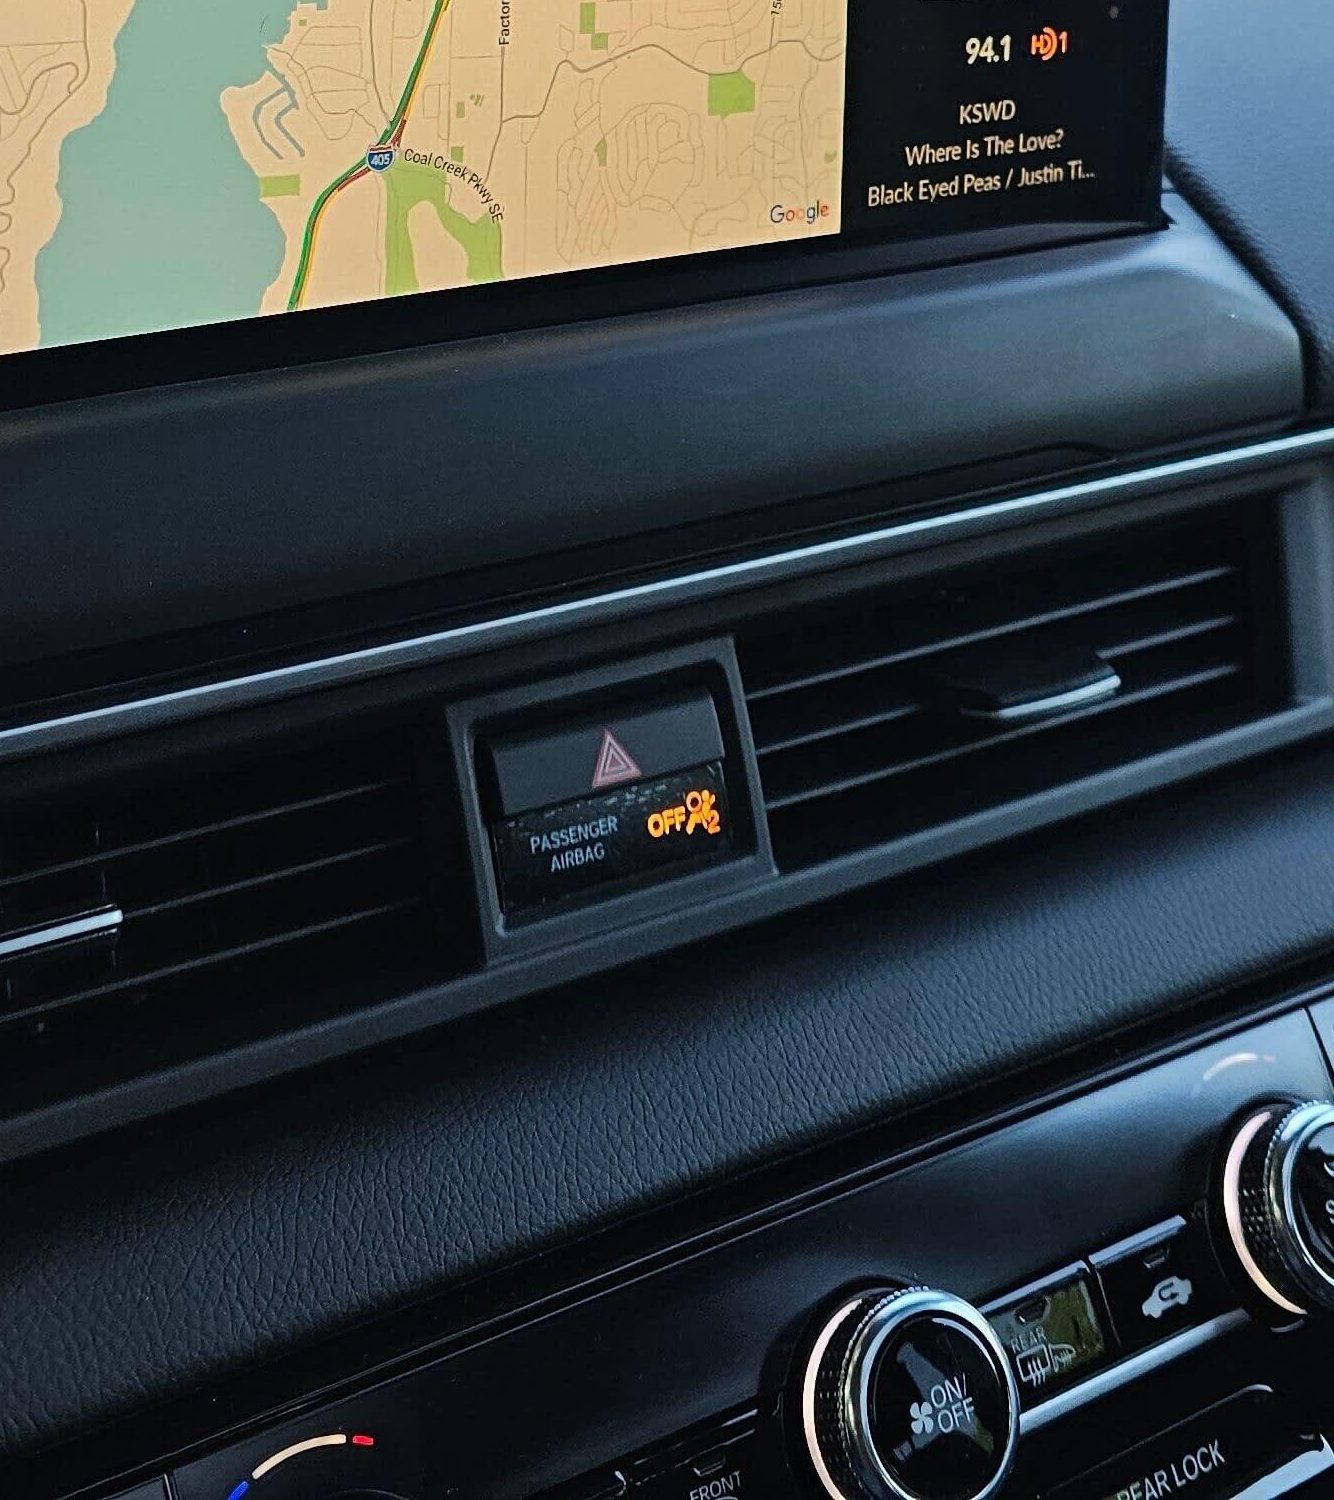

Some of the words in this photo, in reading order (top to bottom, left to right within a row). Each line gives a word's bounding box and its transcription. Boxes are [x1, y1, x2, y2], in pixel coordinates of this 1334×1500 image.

[965, 34, 1012, 65] 94.1
[959, 99, 1017, 125] KSWD
[370, 153, 390, 166] 405
[905, 143, 961, 167] Where
[966, 139, 980, 159] Is
[984, 135, 1015, 157] The
[1018, 128, 1065, 153] Love?
[404, 148, 434, 166] Coal
[434, 155, 468, 181] Creek
[467, 173, 494, 205] Pkwy
[488, 203, 504, 223] SE
[867, 181, 914, 207] Black
[918, 175, 959, 202] Eyed
[963, 173, 1002, 194] Peas
[1004, 167, 1015, 190] /
[1017, 163, 1064, 188] Justin
[1067, 159, 1096, 180] Ti...
[770, 200, 830, 225] Google
[530, 815, 618, 854] PASSENGER
[647, 805, 686, 838] OFF
[550, 842, 605, 873] AIRBAG
[1010, 1326, 1047, 1355] REAR
[931, 1372, 967, 1408] ON/
[938, 1396, 975, 1433] OFF
[1171, 1439, 1225, 1487] LOCK
